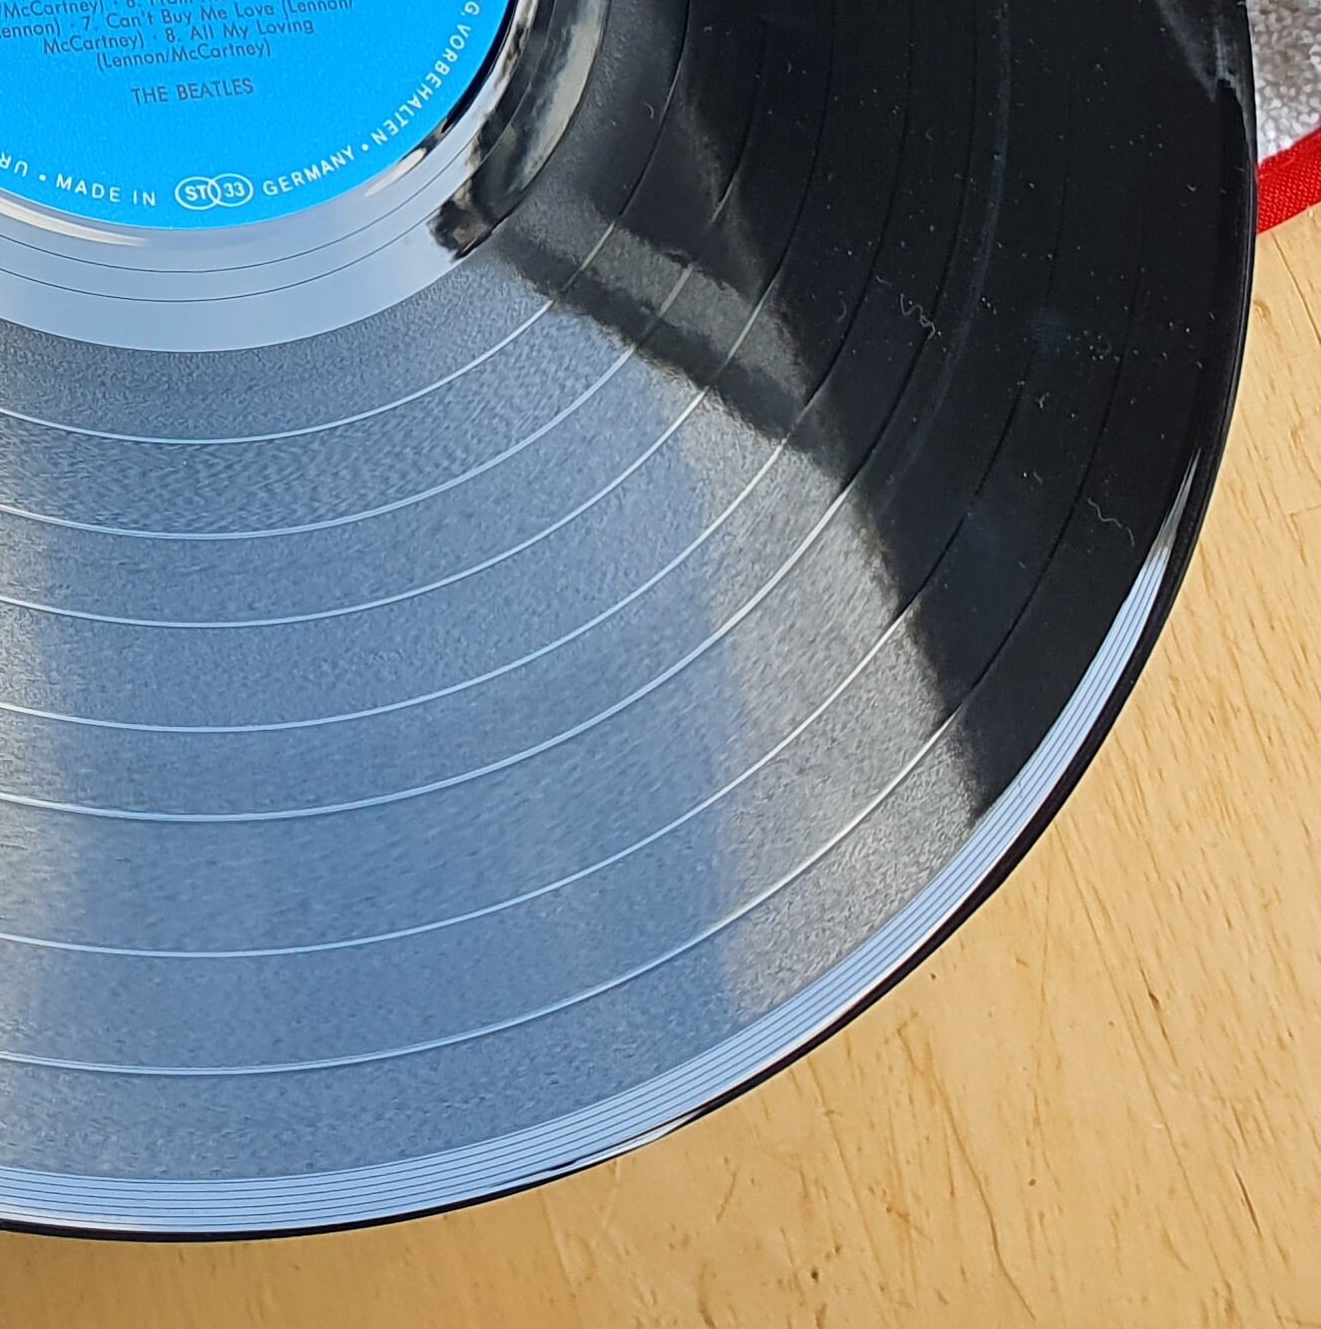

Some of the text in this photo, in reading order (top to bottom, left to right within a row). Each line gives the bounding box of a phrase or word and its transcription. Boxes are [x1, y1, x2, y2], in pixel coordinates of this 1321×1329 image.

[82, 15, 97, 32] 7.
[107, 10, 154, 30] Can't
[161, 8, 193, 29] Buy
[201, 5, 228, 21] Me
[234, 1, 274, 18] Love
[42, 19, 314, 55] McCartney) 8. All My Loving
[97, 40, 271, 72] (Lennon/McCartney)
[132, 78, 254, 105] THE BEATLES
[370, 22, 472, 147] VORBEHALTEN
[55, 144, 356, 207] MADE IN ST 33 GERMANY
